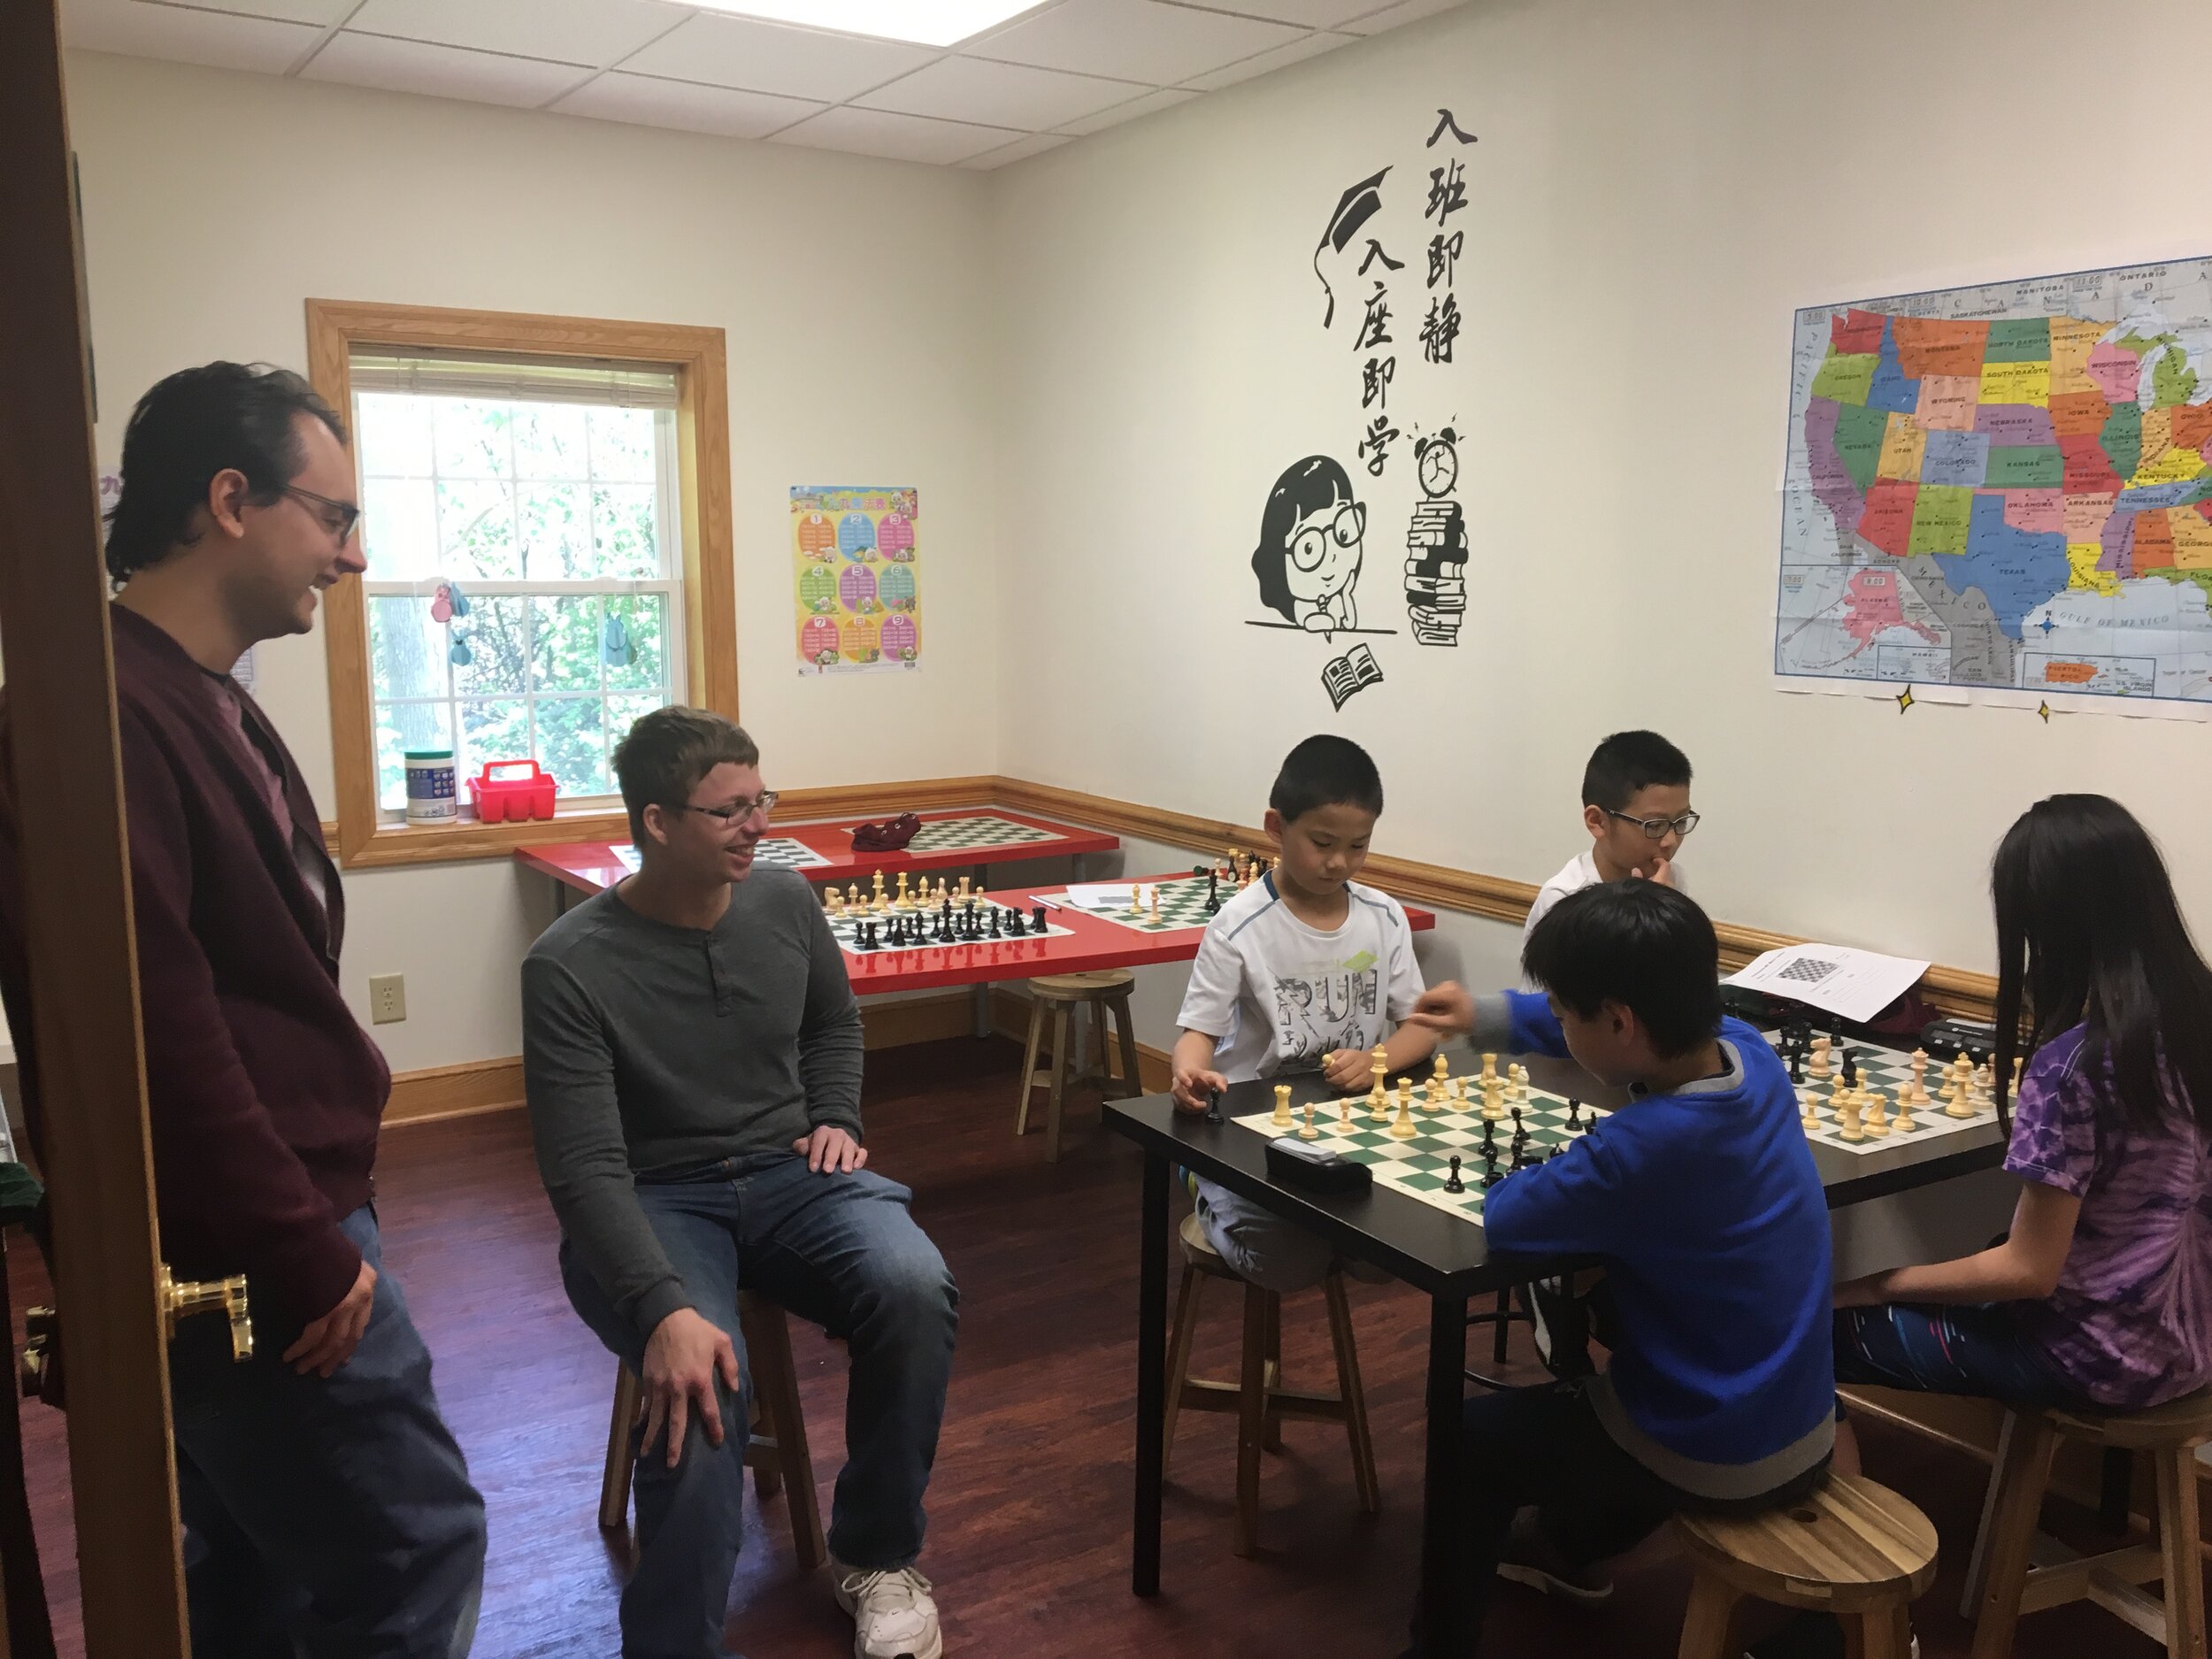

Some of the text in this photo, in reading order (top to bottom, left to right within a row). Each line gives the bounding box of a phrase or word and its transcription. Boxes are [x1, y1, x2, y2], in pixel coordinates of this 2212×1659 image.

[1418, 108, 1479, 364] 入班即静
[2119, 271, 2167, 280] ONTARIO
[2016, 284, 2064, 295] MANITOBA
[1950, 308, 2008, 319] SASKATCHEWAN
[2016, 337, 2048, 346] DAKOTA
[2053, 331, 2101, 341] MINNESOTA
[1353, 238, 1405, 477] 入座即学
[2155, 335, 2179, 375] MICHIGAN
[2091, 359, 2137, 369] WISCONSIN
[2016, 367, 2049, 376] DAKOTA
[2068, 556, 2101, 588] LOUISIANA
[2060, 611, 2091, 625] GULF
[2120, 615, 2170, 627] MEXICO
